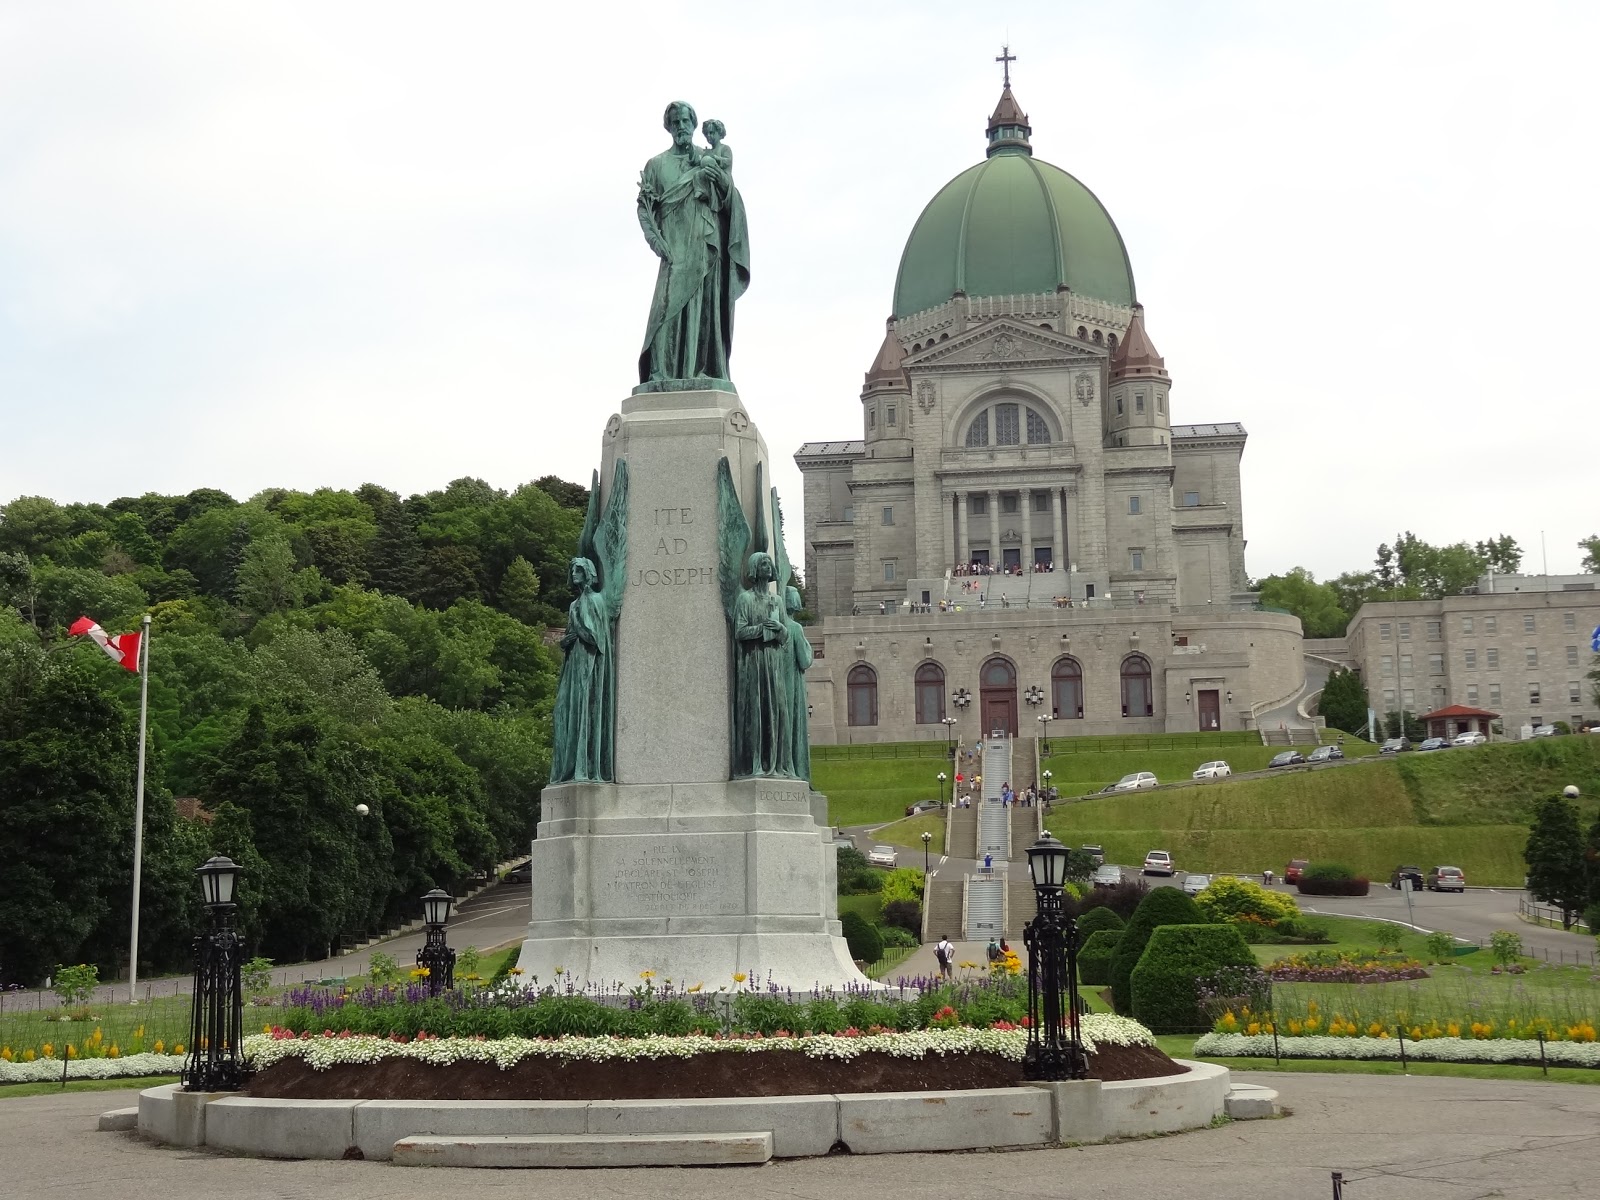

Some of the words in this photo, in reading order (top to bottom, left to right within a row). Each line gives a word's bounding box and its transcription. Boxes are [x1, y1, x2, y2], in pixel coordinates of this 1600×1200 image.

[653, 507, 694, 526] ITE
[653, 536, 688, 556] AD
[631, 567, 714, 587] JOSEPH
[759, 790, 807, 802] ECCLESIA
